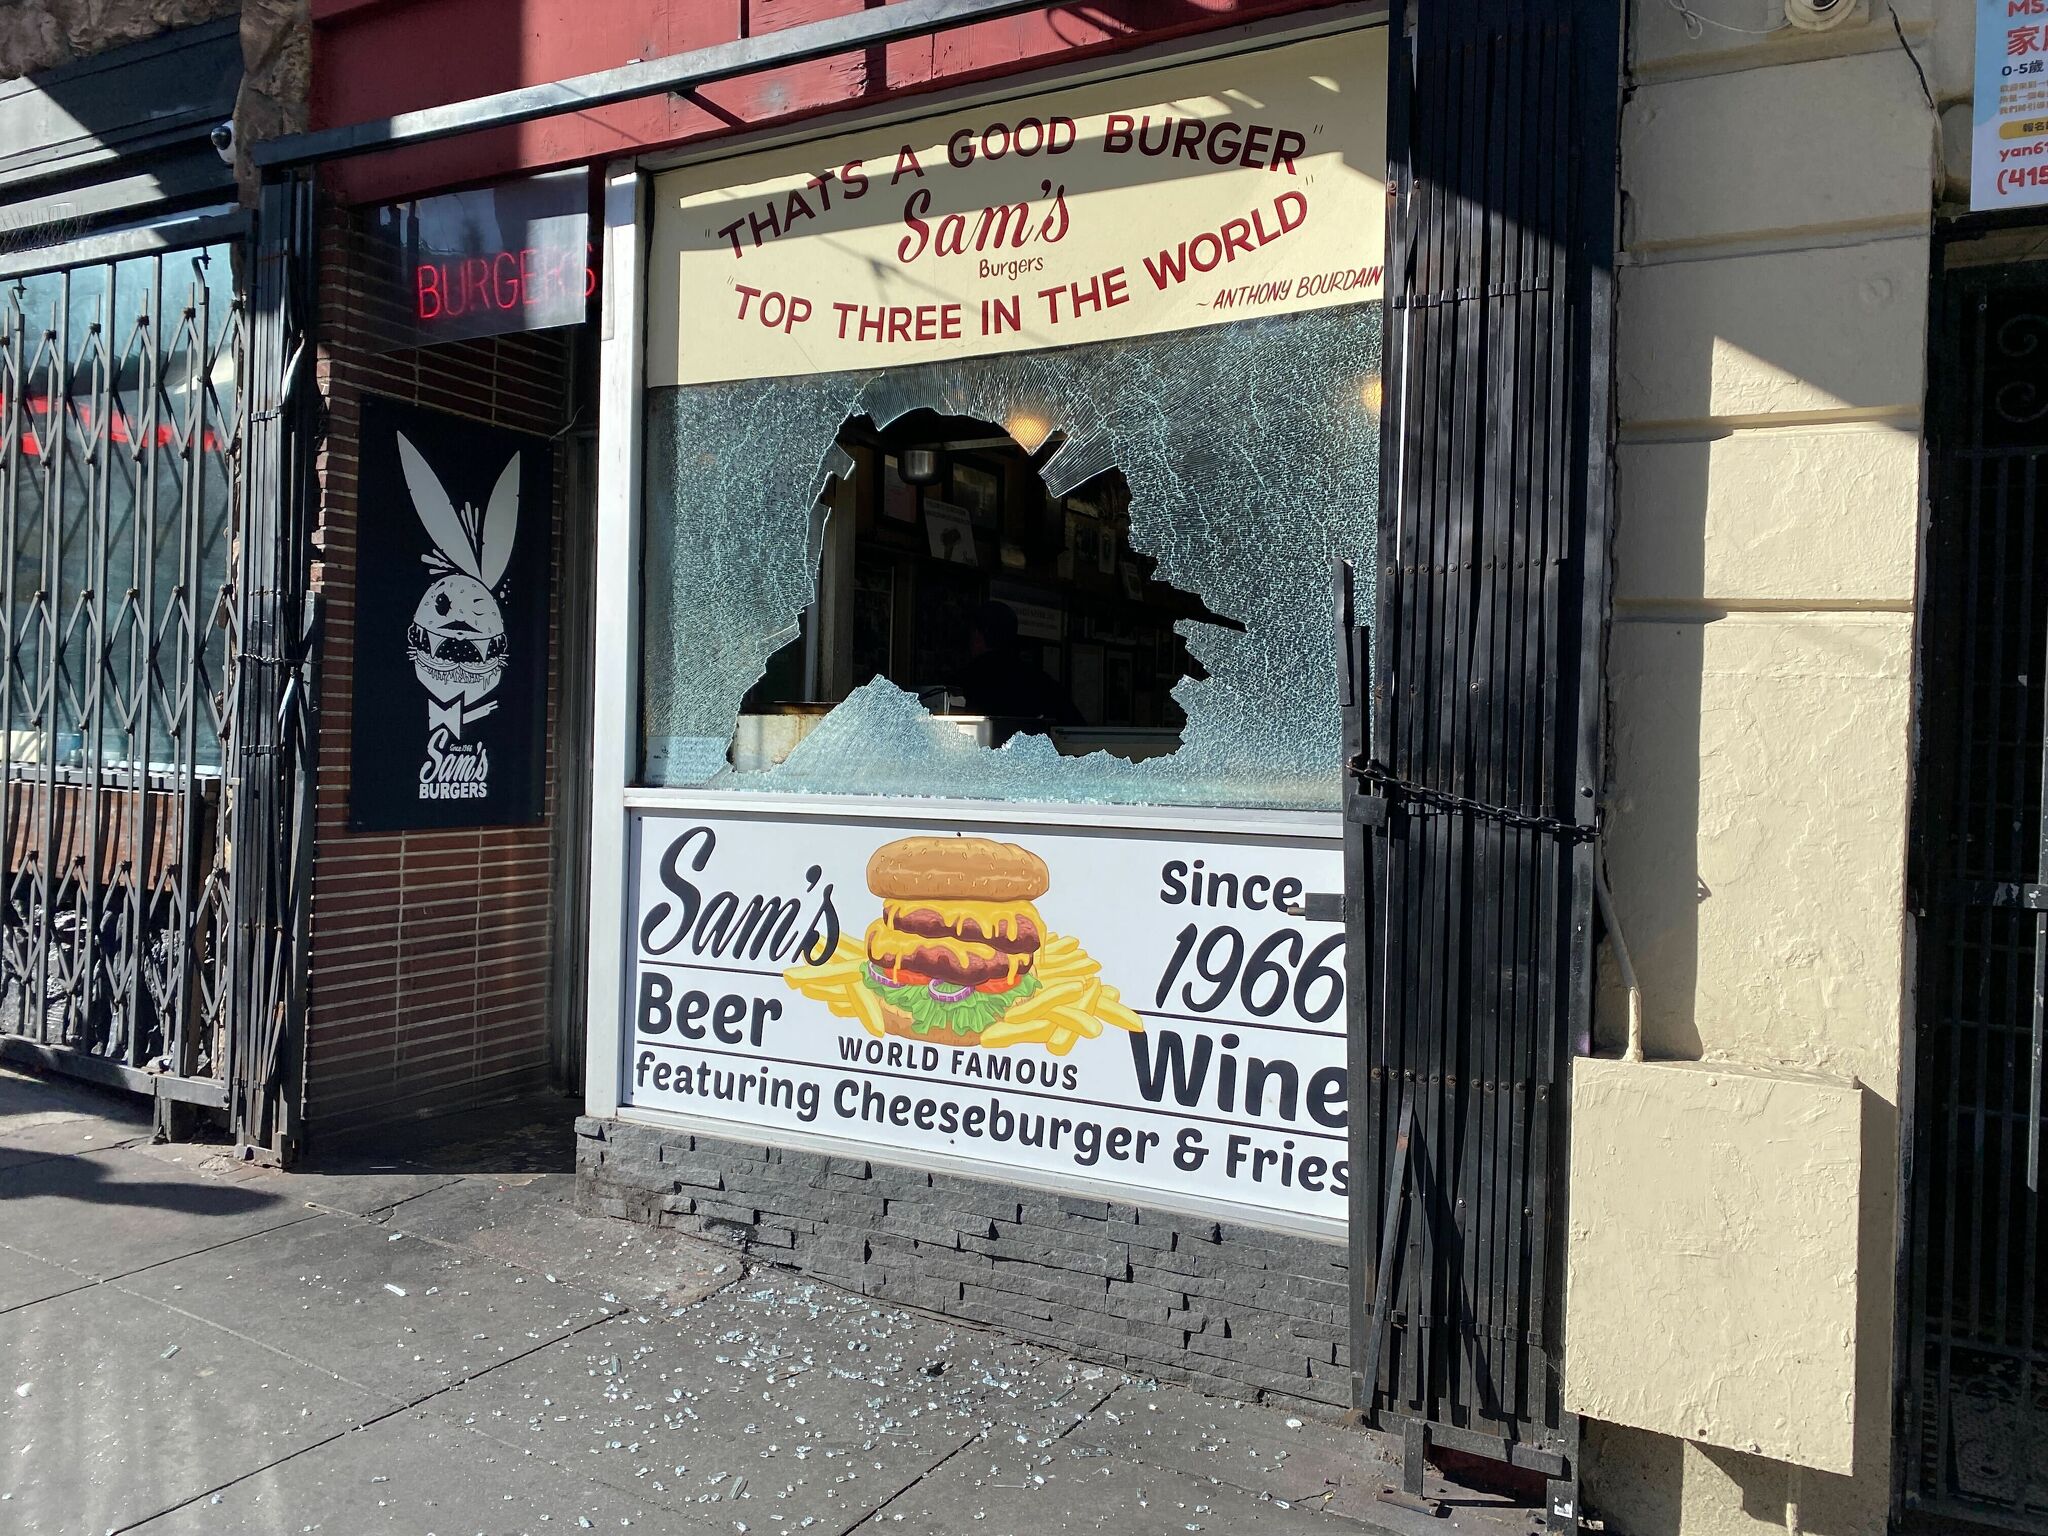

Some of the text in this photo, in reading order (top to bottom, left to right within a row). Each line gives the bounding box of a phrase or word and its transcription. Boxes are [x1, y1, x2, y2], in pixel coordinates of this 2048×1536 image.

[2007, 25, 2048, 56] 家
[891, 145, 924, 185] A
[947, 117, 1076, 168] GOOD
[2022, 121, 2048, 132] 報名
[898, 179, 1069, 263] Sam's
[417, 242, 597, 320] BURGERS
[979, 256, 1044, 281] Burgers
[1295, 265, 1384, 299] BOURDAIN
[832, 302, 961, 343] THREE
[981, 295, 1021, 336] IN
[1038, 266, 1130, 324] THE
[420, 728, 489, 784] Sam's
[418, 781, 488, 800] BURGERS
[640, 826, 840, 966] Sam's
[1160, 859, 1303, 913] Since
[1156, 923, 1346, 1023] 1966
[637, 971, 783, 1047] Beer
[837, 1036, 1078, 1091] WORLD FAMOUS
[1129, 1029, 1348, 1129] Wine
[636, 1051, 1349, 1197] featuring Cheeseburger & Fries
